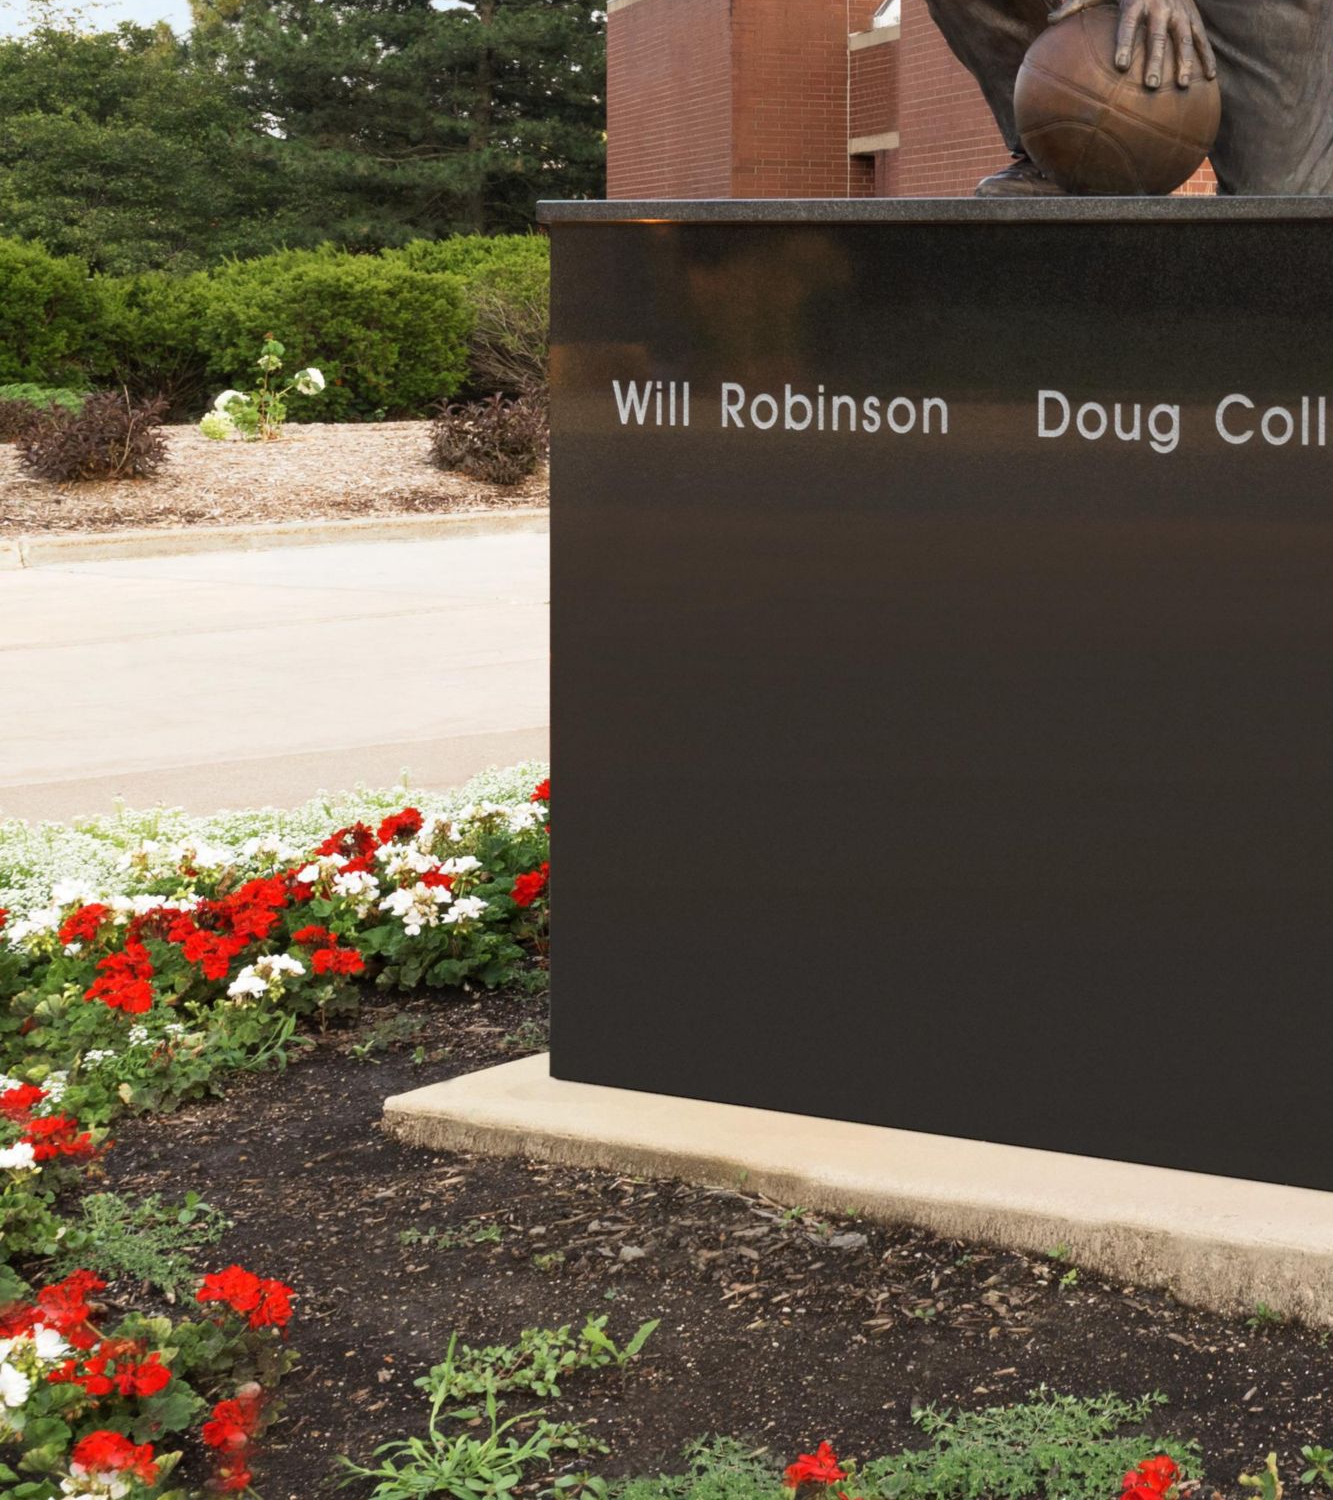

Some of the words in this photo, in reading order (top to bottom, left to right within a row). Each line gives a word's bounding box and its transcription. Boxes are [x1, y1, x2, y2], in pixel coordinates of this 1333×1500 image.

[611, 379, 690, 428] Will
[721, 382, 949, 435] Robinson
[1037, 389, 1180, 454] Doug
